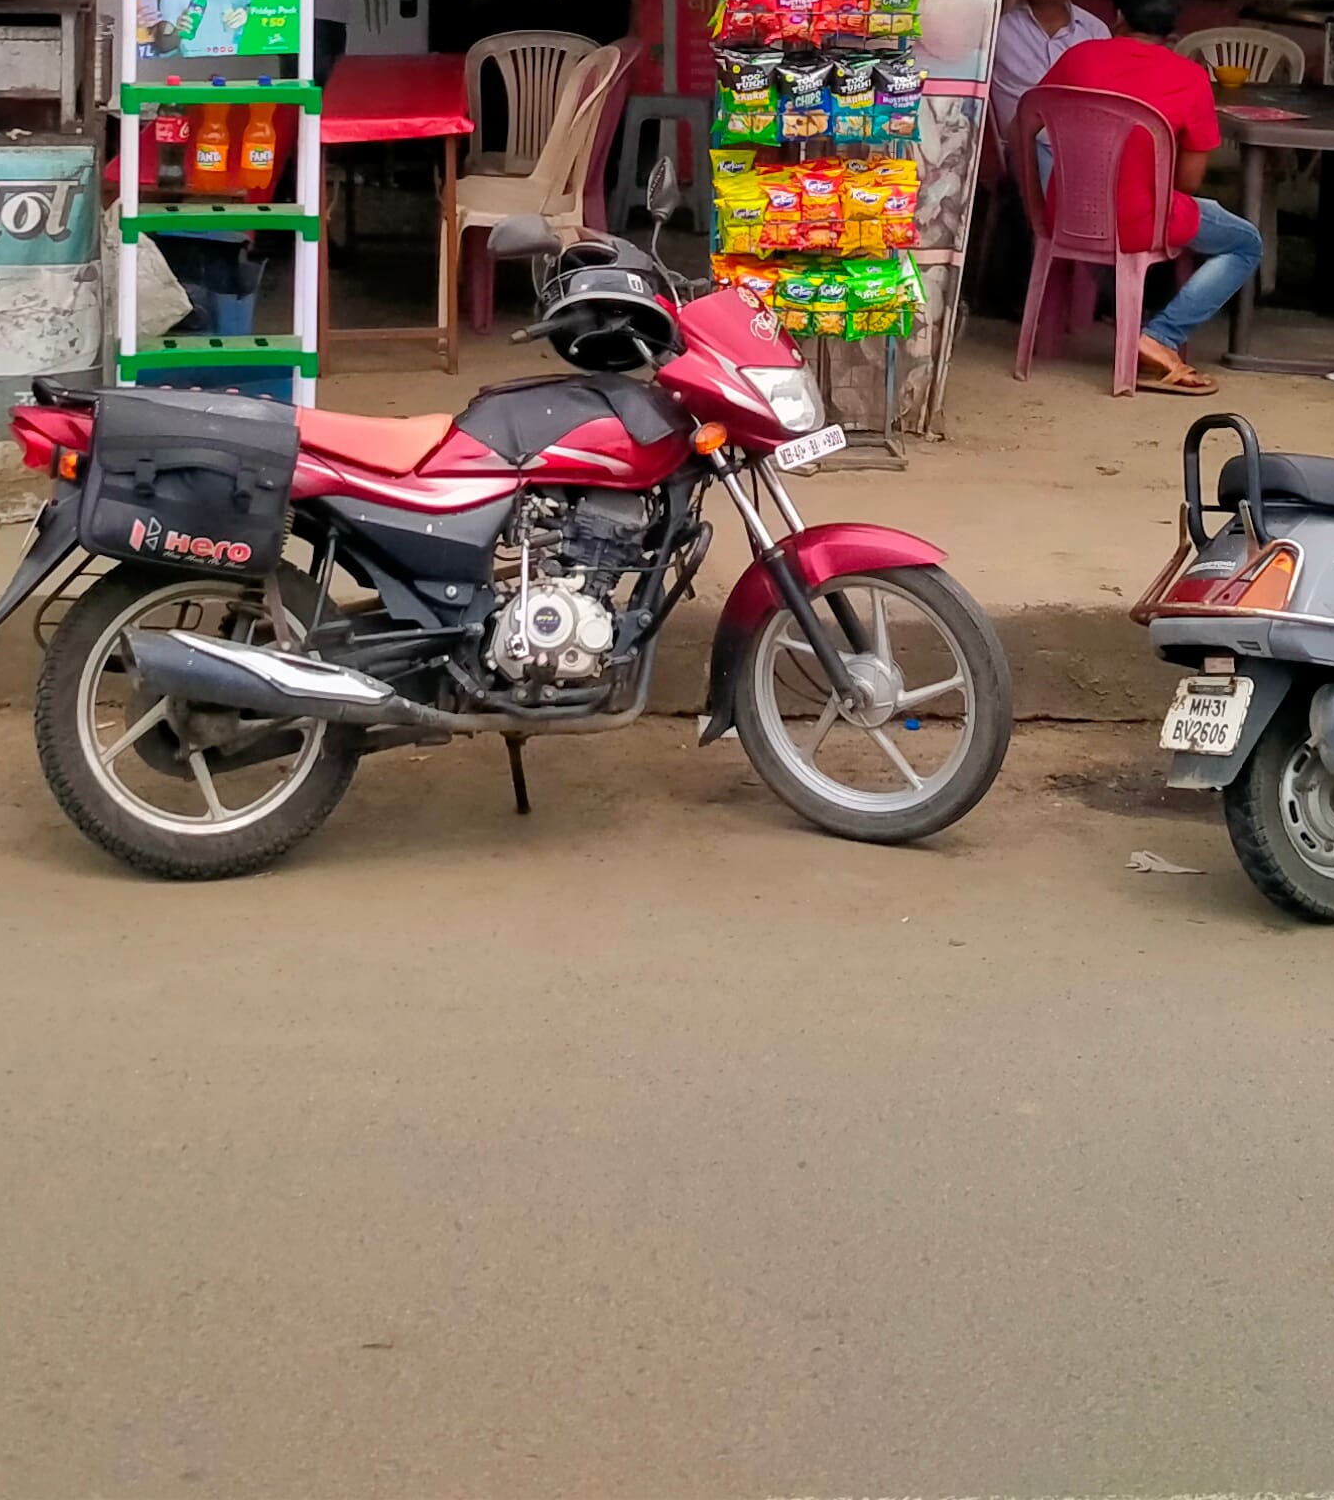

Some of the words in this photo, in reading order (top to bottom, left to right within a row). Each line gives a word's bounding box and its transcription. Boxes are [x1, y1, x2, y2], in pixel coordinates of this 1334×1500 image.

[794, 90, 822, 108] CHIPS
[164, 530, 252, 563] Hero
[1172, 719, 1229, 745] BV2606
